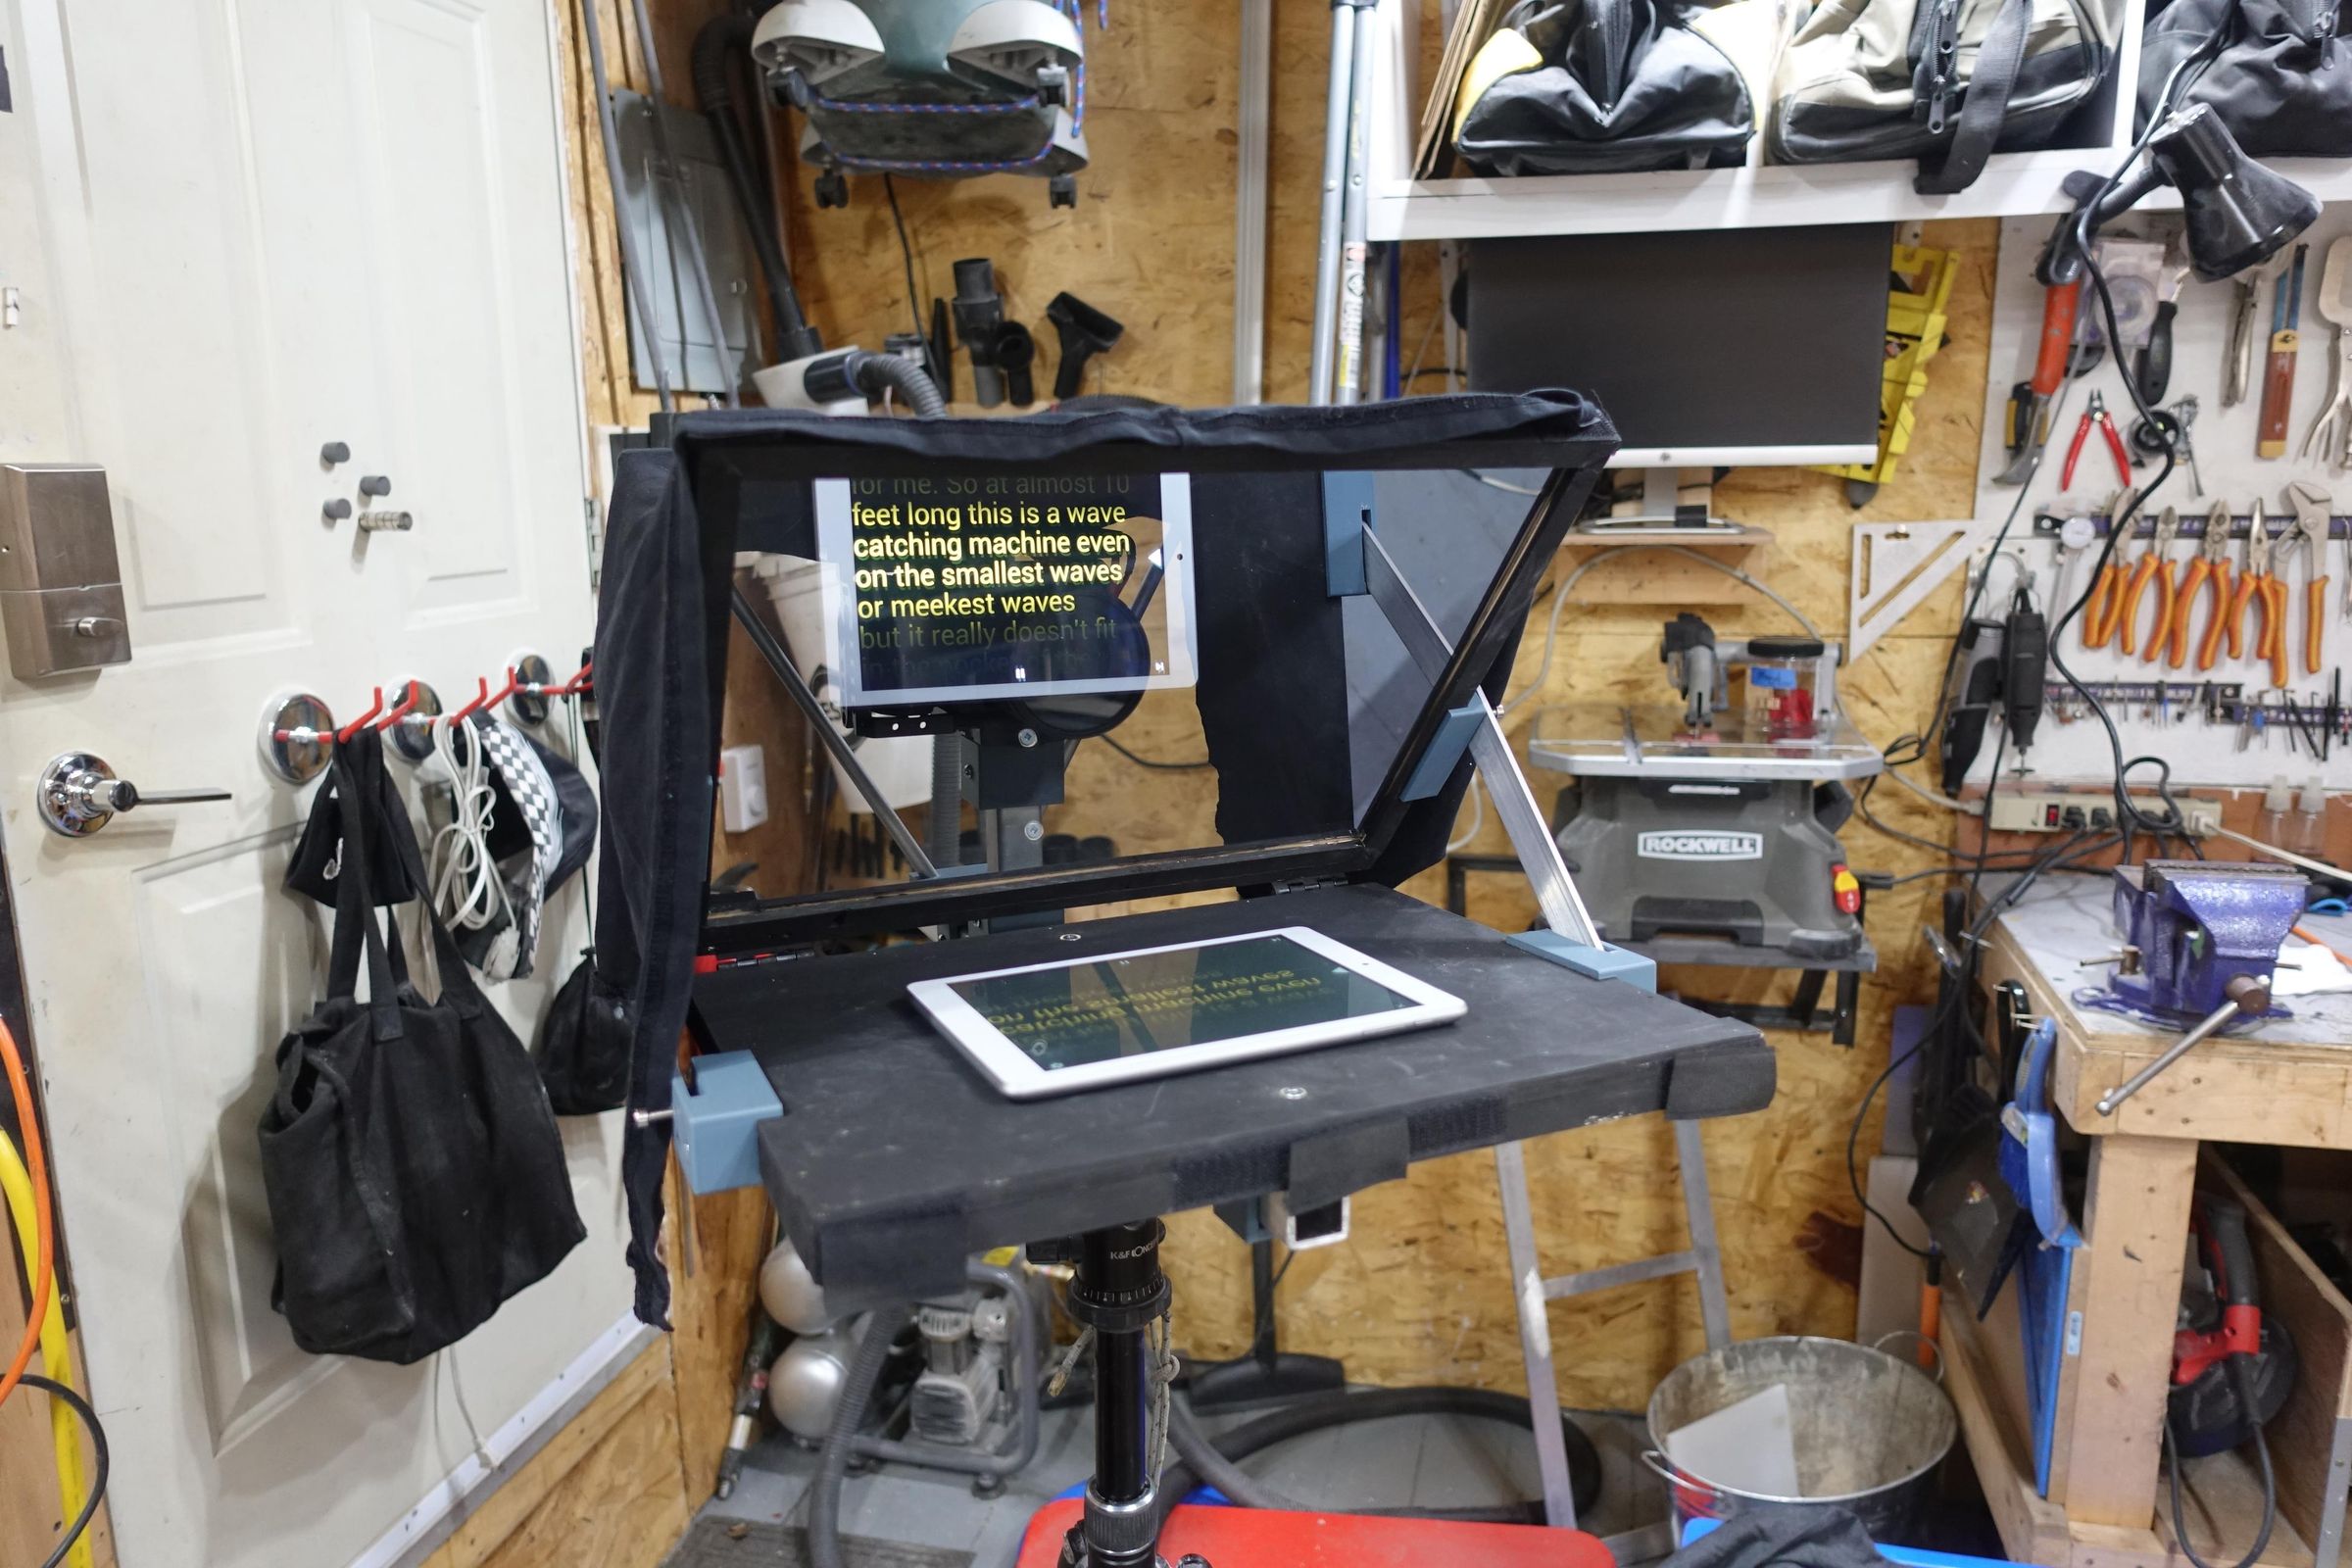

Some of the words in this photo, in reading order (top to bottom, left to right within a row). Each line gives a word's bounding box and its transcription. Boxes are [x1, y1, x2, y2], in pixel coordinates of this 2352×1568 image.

[893, 477, 938, 495] me.
[947, 476, 978, 494] So
[986, 477, 1008, 494] at
[1016, 476, 1097, 494] almost
[852, 502, 900, 526] feet
[907, 501, 961, 530] long
[968, 500, 1013, 525] this
[1020, 501, 1040, 524] is
[1048, 507, 1060, 524] a
[1067, 504, 1126, 524] wave
[853, 532, 962, 562] catching
[968, 531, 1071, 556] machine
[1077, 532, 1130, 554] even
[855, 568, 889, 589] on
[896, 564, 935, 588] the
[941, 561, 1043, 586] smallest
[1051, 563, 1123, 584] waves
[858, 598, 883, 619] or
[890, 593, 995, 617] meekest
[1001, 592, 1076, 612] waves
[859, 626, 901, 650] but
[908, 625, 925, 647] it
[932, 622, 996, 651] really
[1004, 619, 1089, 644] doesn't
[1095, 616, 1117, 638] fit
[1646, 836, 1754, 853] ROCKWELL
[1109, 1250, 1130, 1261] K&F
[1131, 1239, 1156, 1257] CONCE
